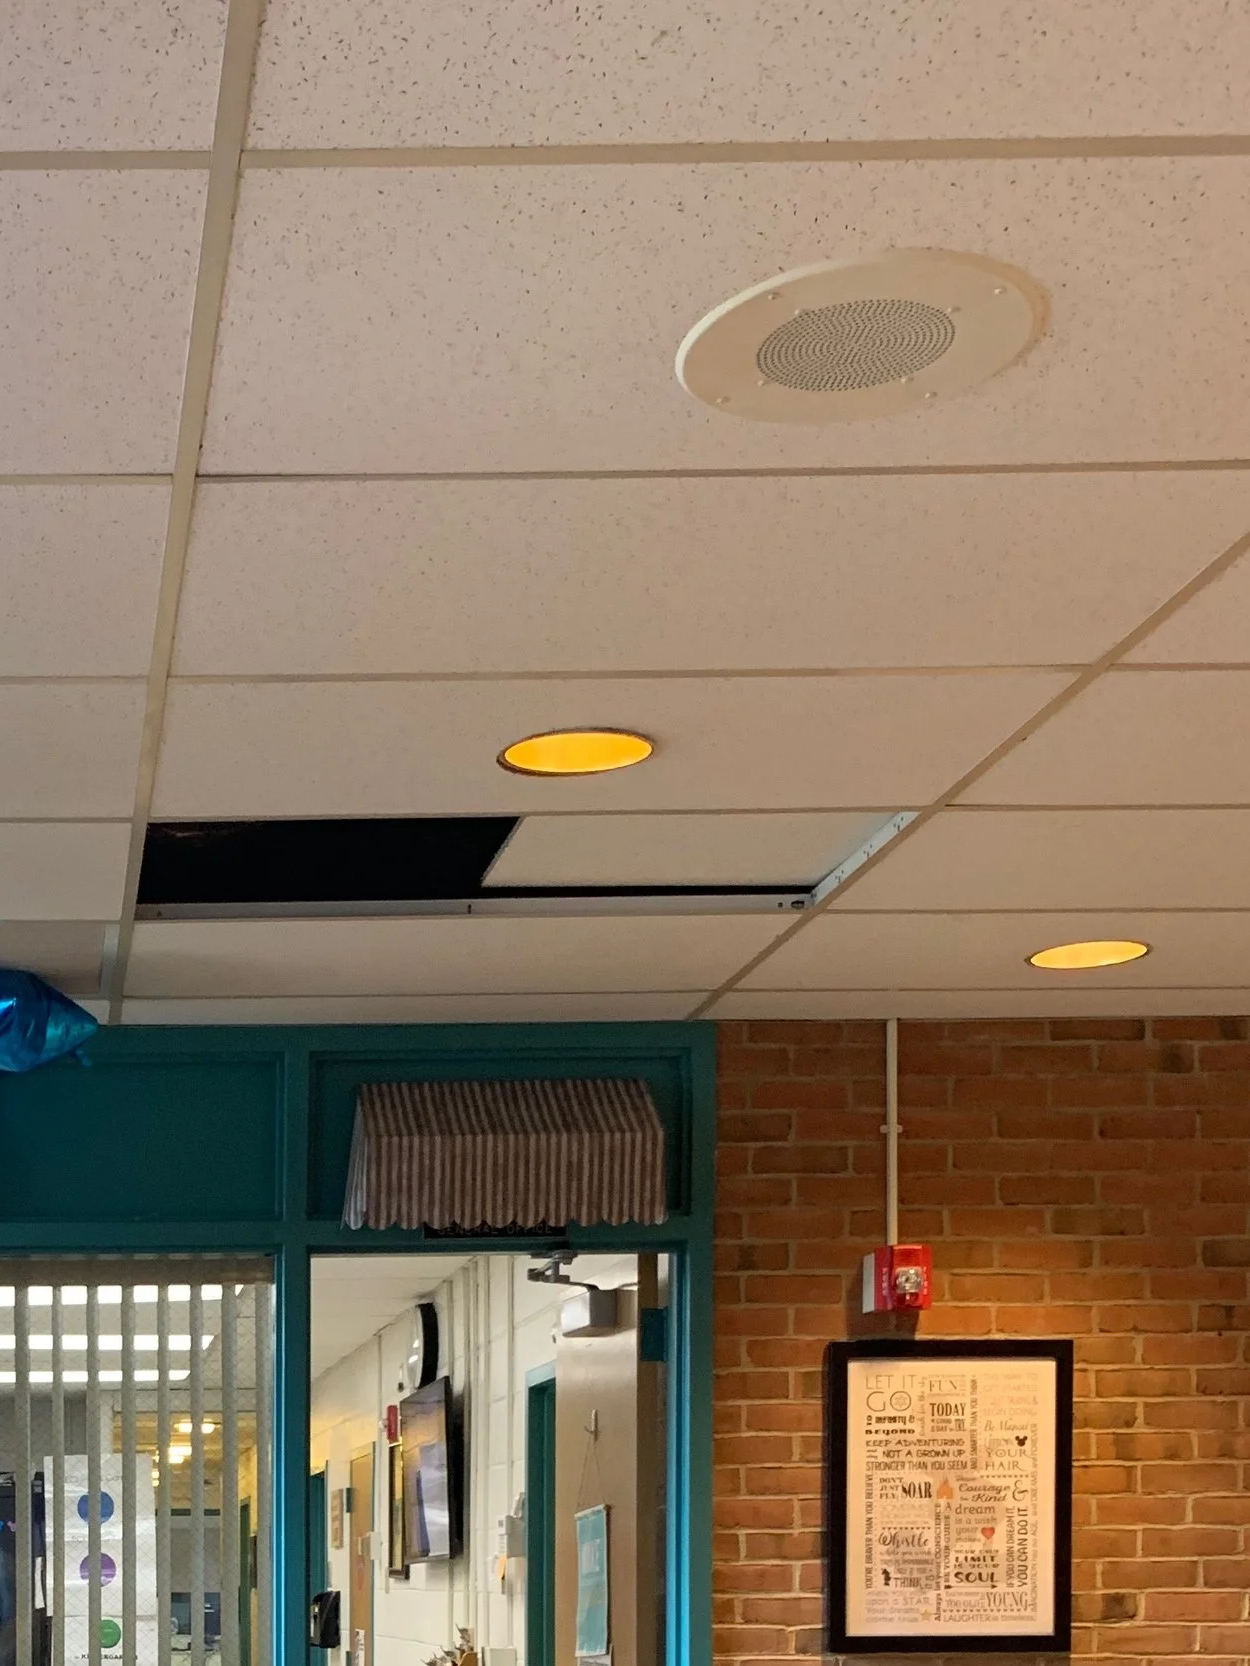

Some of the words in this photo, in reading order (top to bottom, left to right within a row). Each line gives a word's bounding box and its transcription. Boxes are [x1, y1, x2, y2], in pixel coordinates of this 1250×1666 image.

[866, 1374, 895, 1390] LET
[902, 1374, 917, 1390] IT
[866, 1390, 912, 1412] GO
[929, 1402, 967, 1417] TODAY
[865, 1439, 892, 1447] KEEP
[895, 1438, 965, 1447] ADVENTURING
[882, 1449, 903, 1458] NOT
[905, 1449, 913, 1458] A
[916, 1449, 950, 1458] GROWN
[952, 1449, 966, 1458] UP
[985, 1448, 1034, 1459] YOUR
[865, 1460, 905, 1471] STRONGER
[907, 1460, 928, 1471] THAN
[930, 1460, 946, 1471] YOU
[947, 1460, 968, 1471] SEEM
[985, 1460, 1030, 1472] HAIR
[901, 1480, 933, 1499] SOAR
[958, 1482, 1011, 1495] Courage
[1012, 1479, 1029, 1502] &
[970, 1493, 1008, 1503] Kind
[955, 1502, 996, 1515] dream
[1005, 1516, 1015, 1545] DREAM
[1016, 1519, 1029, 1535] DO
[878, 1531, 930, 1549] Whistle
[1005, 1546, 1015, 1563] CAN
[1016, 1538, 1029, 1562] CAN
[954, 1571, 1002, 1583] SOUL
[1016, 1564, 1029, 1588] YOU
[943, 1613, 991, 1623] LAUGHTER
